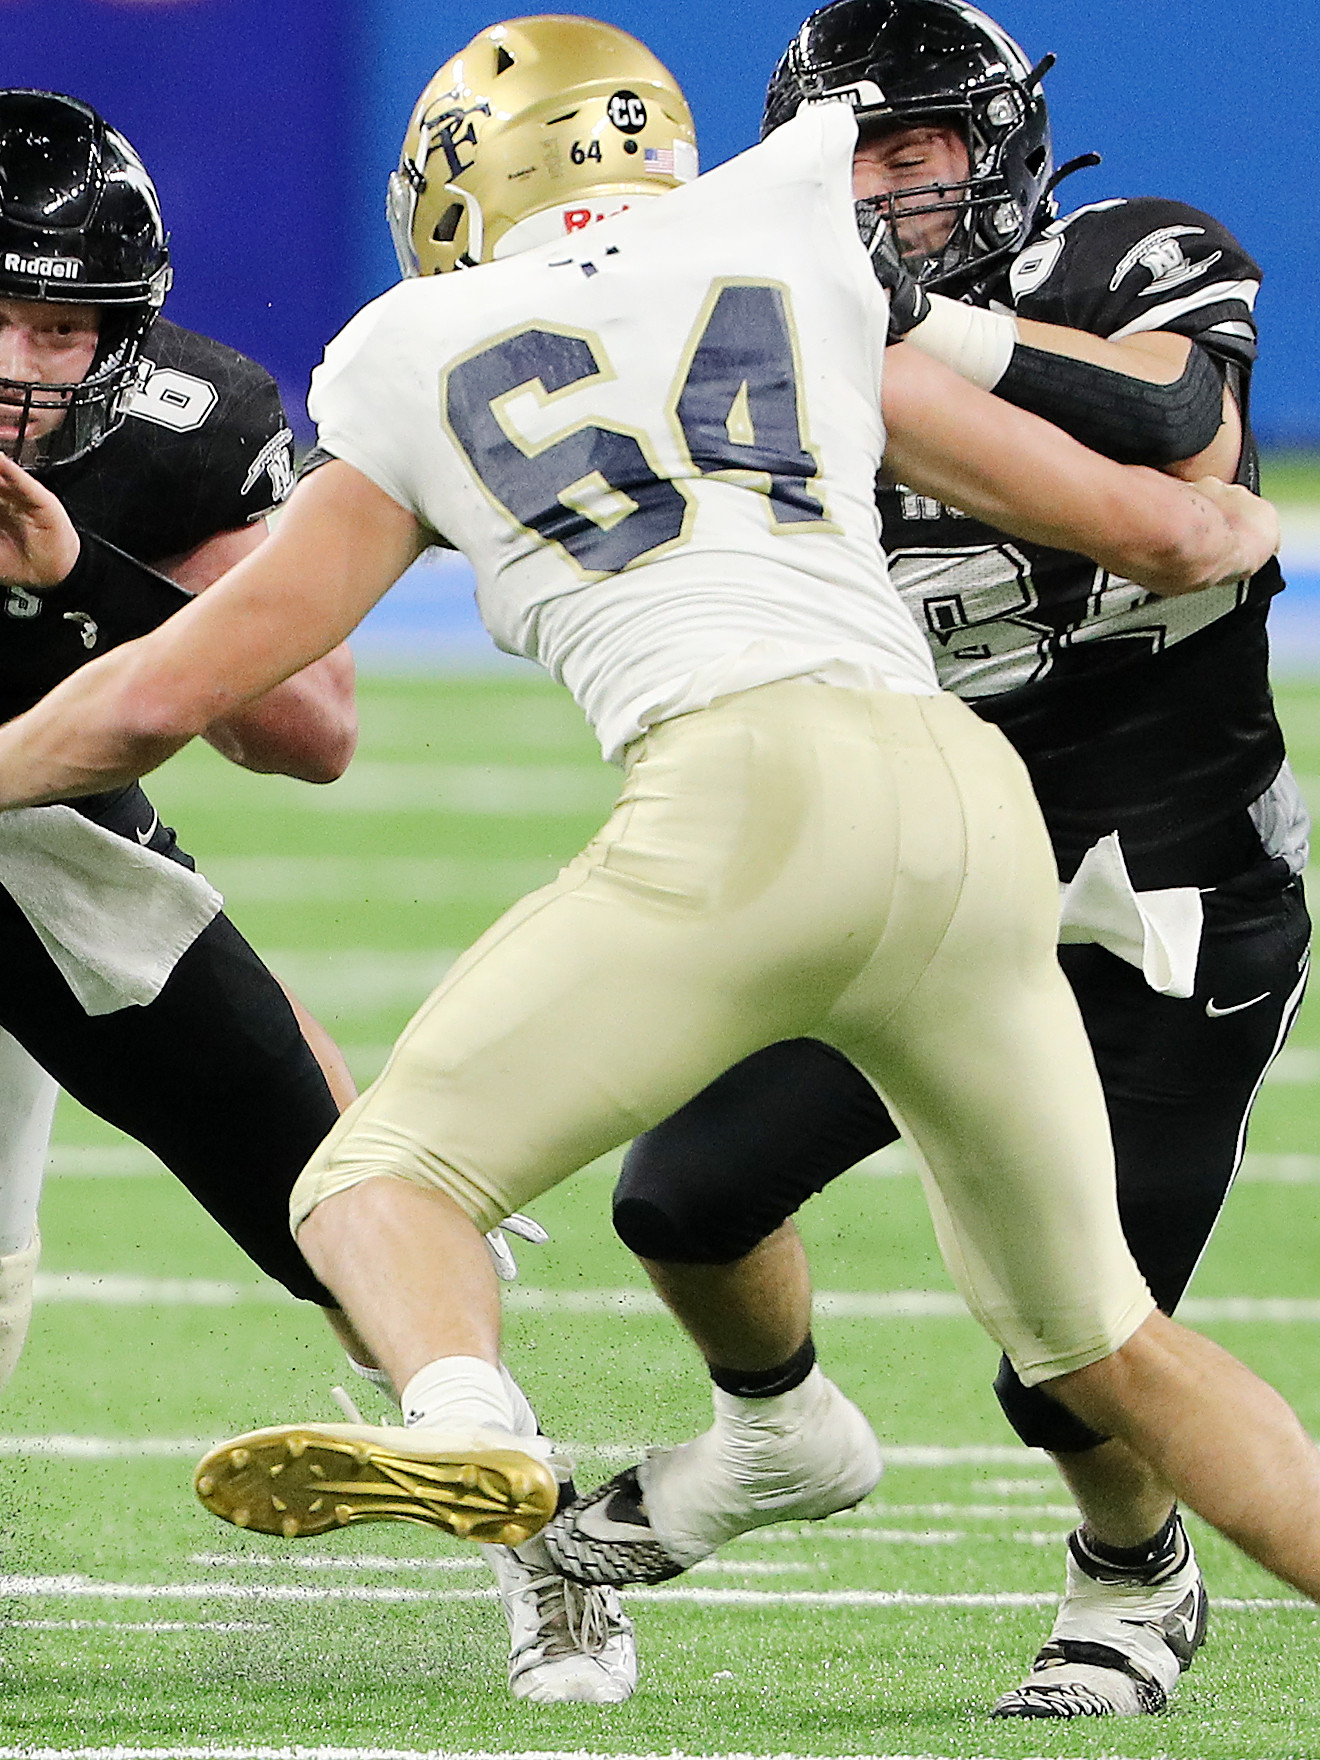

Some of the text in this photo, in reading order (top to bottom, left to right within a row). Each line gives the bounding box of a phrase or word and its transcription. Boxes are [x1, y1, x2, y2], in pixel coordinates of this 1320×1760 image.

[611, 97, 645, 128] CC
[570, 140, 602, 165] 64
[4, 252, 79, 280] Riddell
[439, 276, 846, 582] 64
